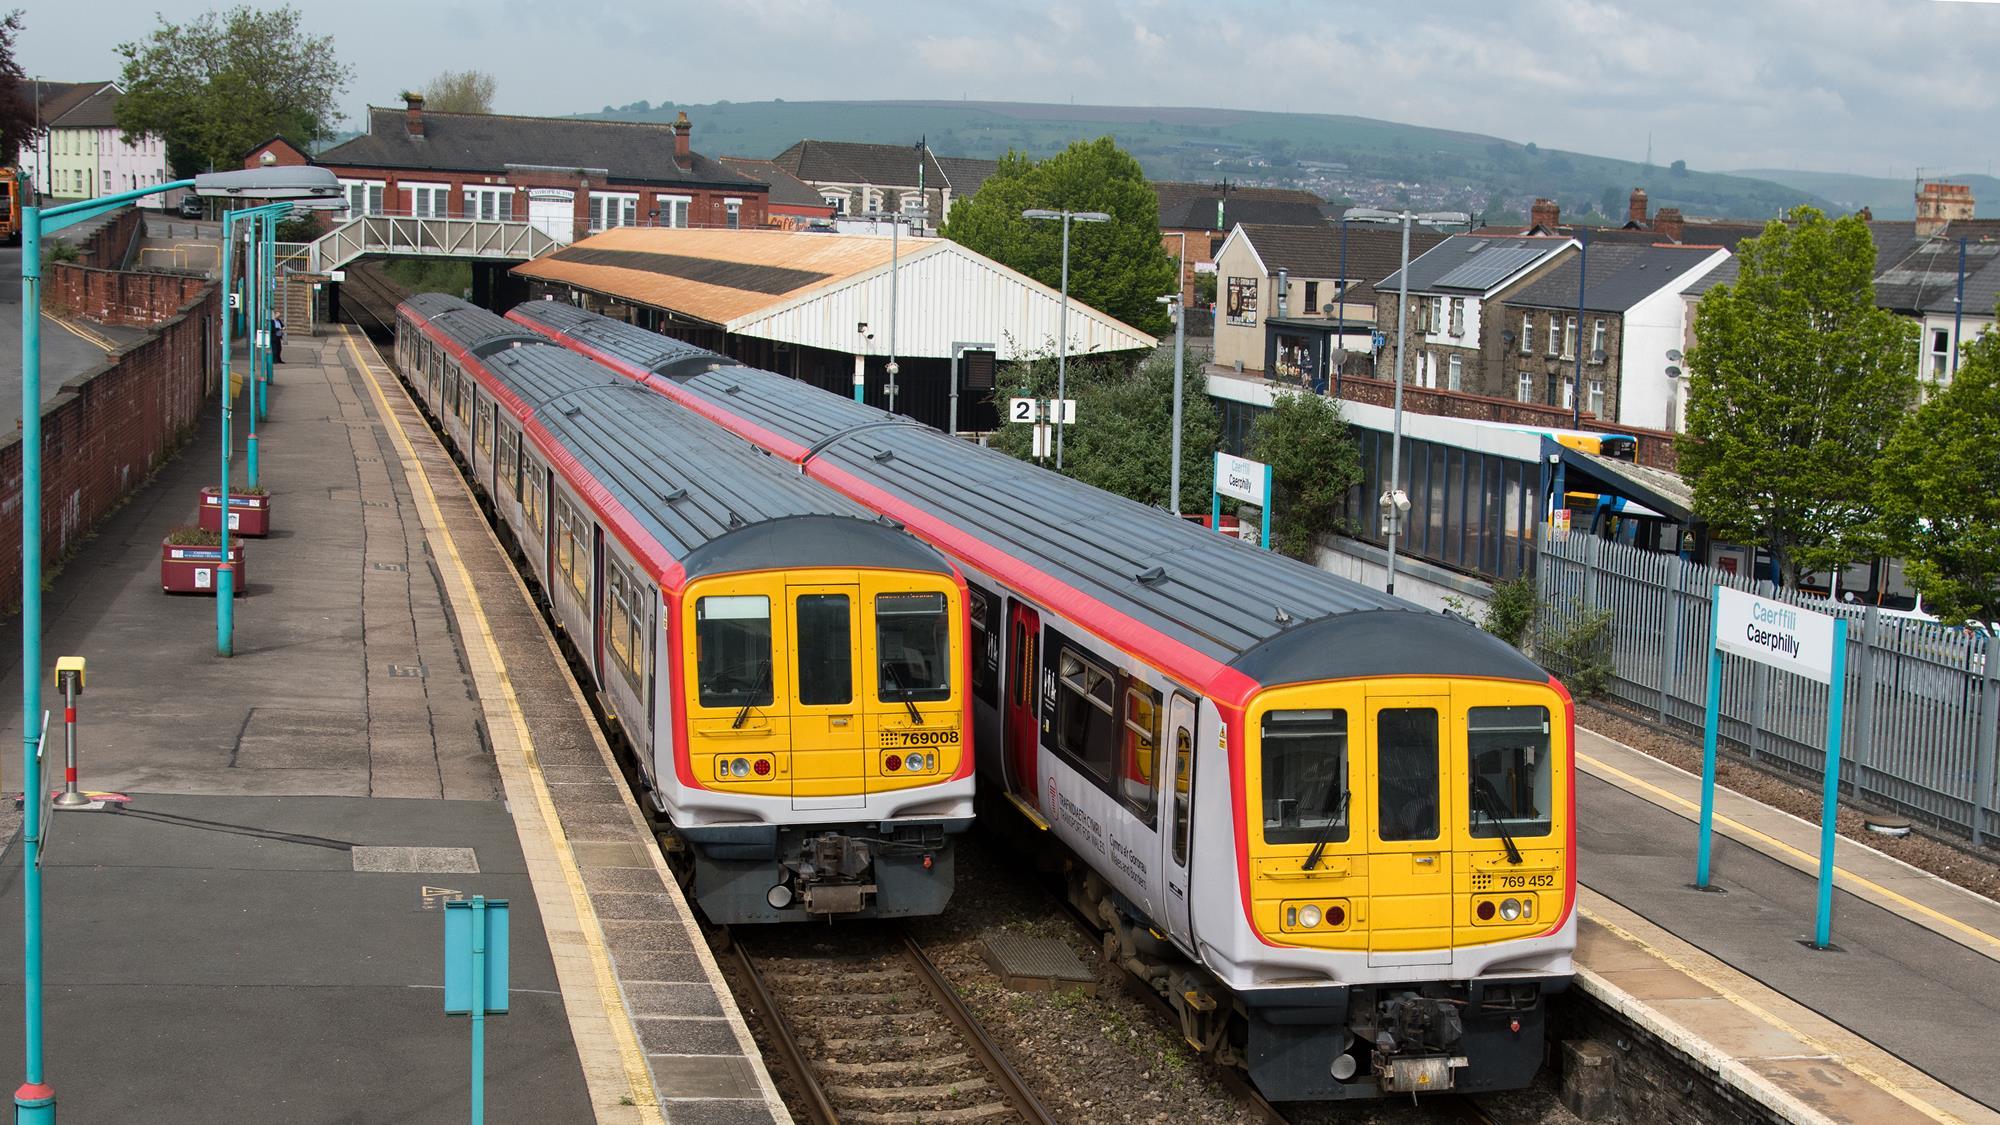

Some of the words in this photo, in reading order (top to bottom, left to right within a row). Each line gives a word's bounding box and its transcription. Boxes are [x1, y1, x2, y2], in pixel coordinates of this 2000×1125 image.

[1016, 402, 1030, 420] 2
[1228, 473, 1252, 494] Caerphilly
[1752, 601, 1797, 632] Caerffili
[1746, 623, 1800, 659] Caerphilly
[900, 731, 959, 746] 769008
[1501, 876, 1525, 888] 769
[1528, 875, 1554, 887] 452
